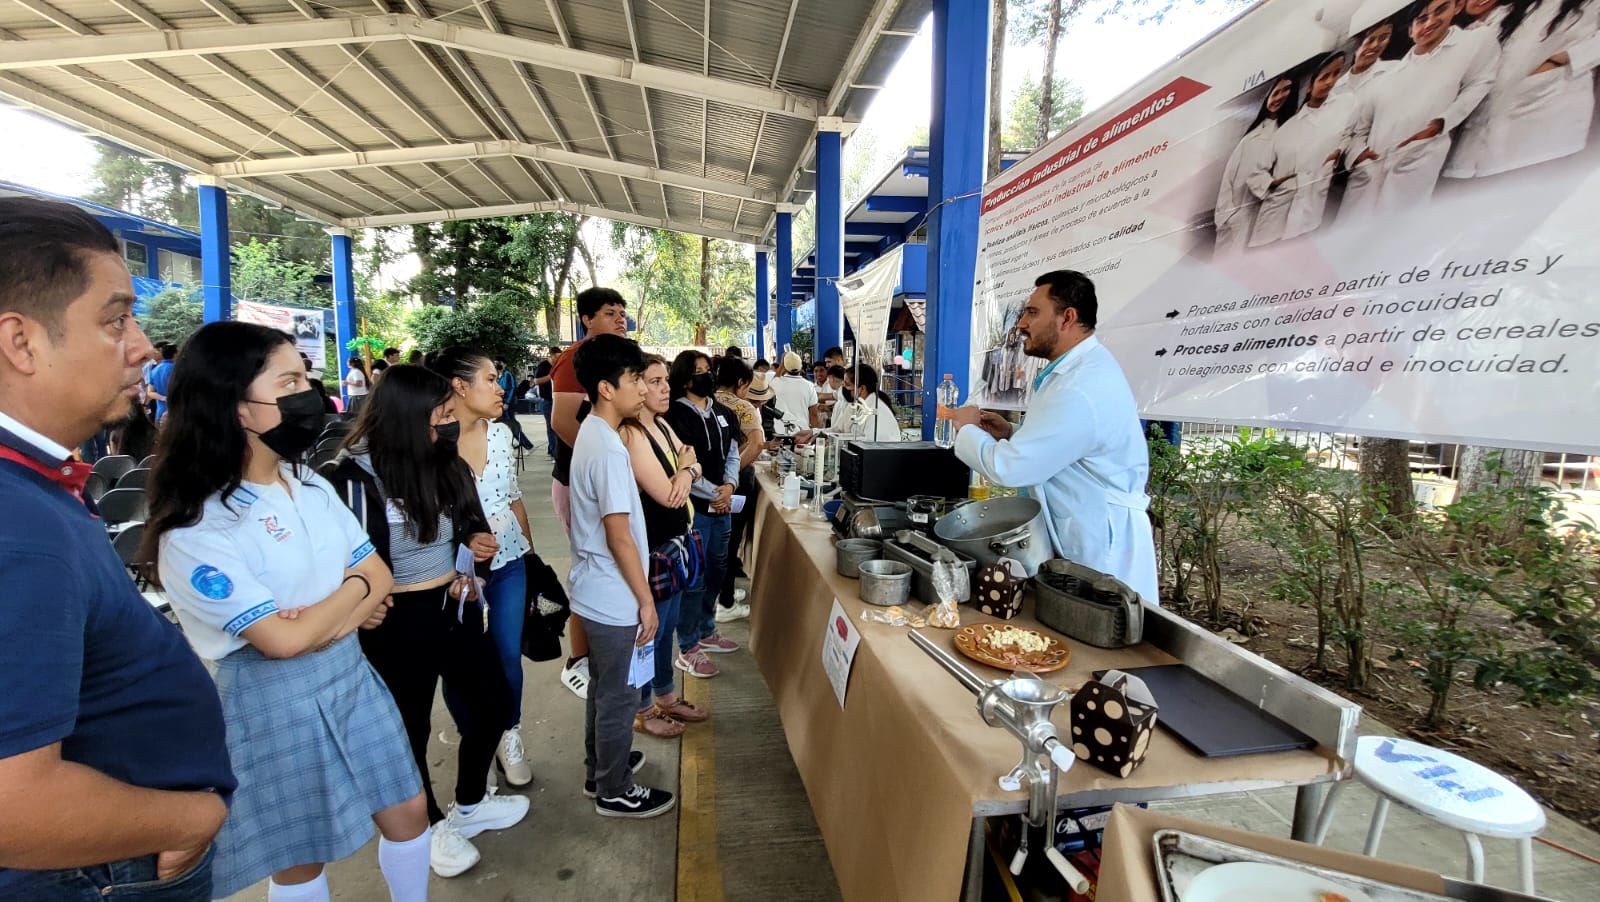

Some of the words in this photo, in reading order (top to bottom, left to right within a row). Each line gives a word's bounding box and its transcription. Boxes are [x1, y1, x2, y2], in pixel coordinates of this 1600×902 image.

[984, 178, 1031, 209] Producción
[1031, 144, 1081, 184] industrial
[1082, 137, 1099, 154] de
[1101, 91, 1177, 143] alimentos
[1053, 175, 1096, 204] industrial
[1096, 170, 1110, 183] de
[1111, 140, 1169, 175] alimentos
[1150, 169, 1158, 178] a
[1098, 196, 1132, 216] acuerdo
[1092, 235, 1107, 247] con
[1108, 219, 1146, 241] calidad
[1186, 300, 1237, 317] Procesa
[1239, 286, 1313, 309] alimentos
[1318, 283, 1329, 296] a
[1332, 270, 1391, 296] partir
[1398, 266, 1431, 285] de
[1441, 257, 1529, 281] frutas
[1536, 254, 1564, 276] y
[1180, 320, 1239, 337] hortalizas
[1243, 316, 1270, 330] con
[1274, 304, 1338, 327] calidad
[1342, 304, 1355, 318] e
[1362, 287, 1503, 317] inocuidad
[1173, 341, 1229, 357] Procesa
[1233, 333, 1319, 353] alimentos
[1324, 332, 1336, 346] a
[1341, 326, 1405, 349] partir
[1412, 324, 1446, 343] de
[1456, 318, 1600, 342] cereales
[1167, 367, 1176, 377] u
[1178, 362, 1254, 379] oleaginosas
[1257, 361, 1290, 374] con
[1294, 355, 1374, 374] calidad
[1380, 359, 1395, 373] e
[1402, 353, 1569, 375] inocuidad.
